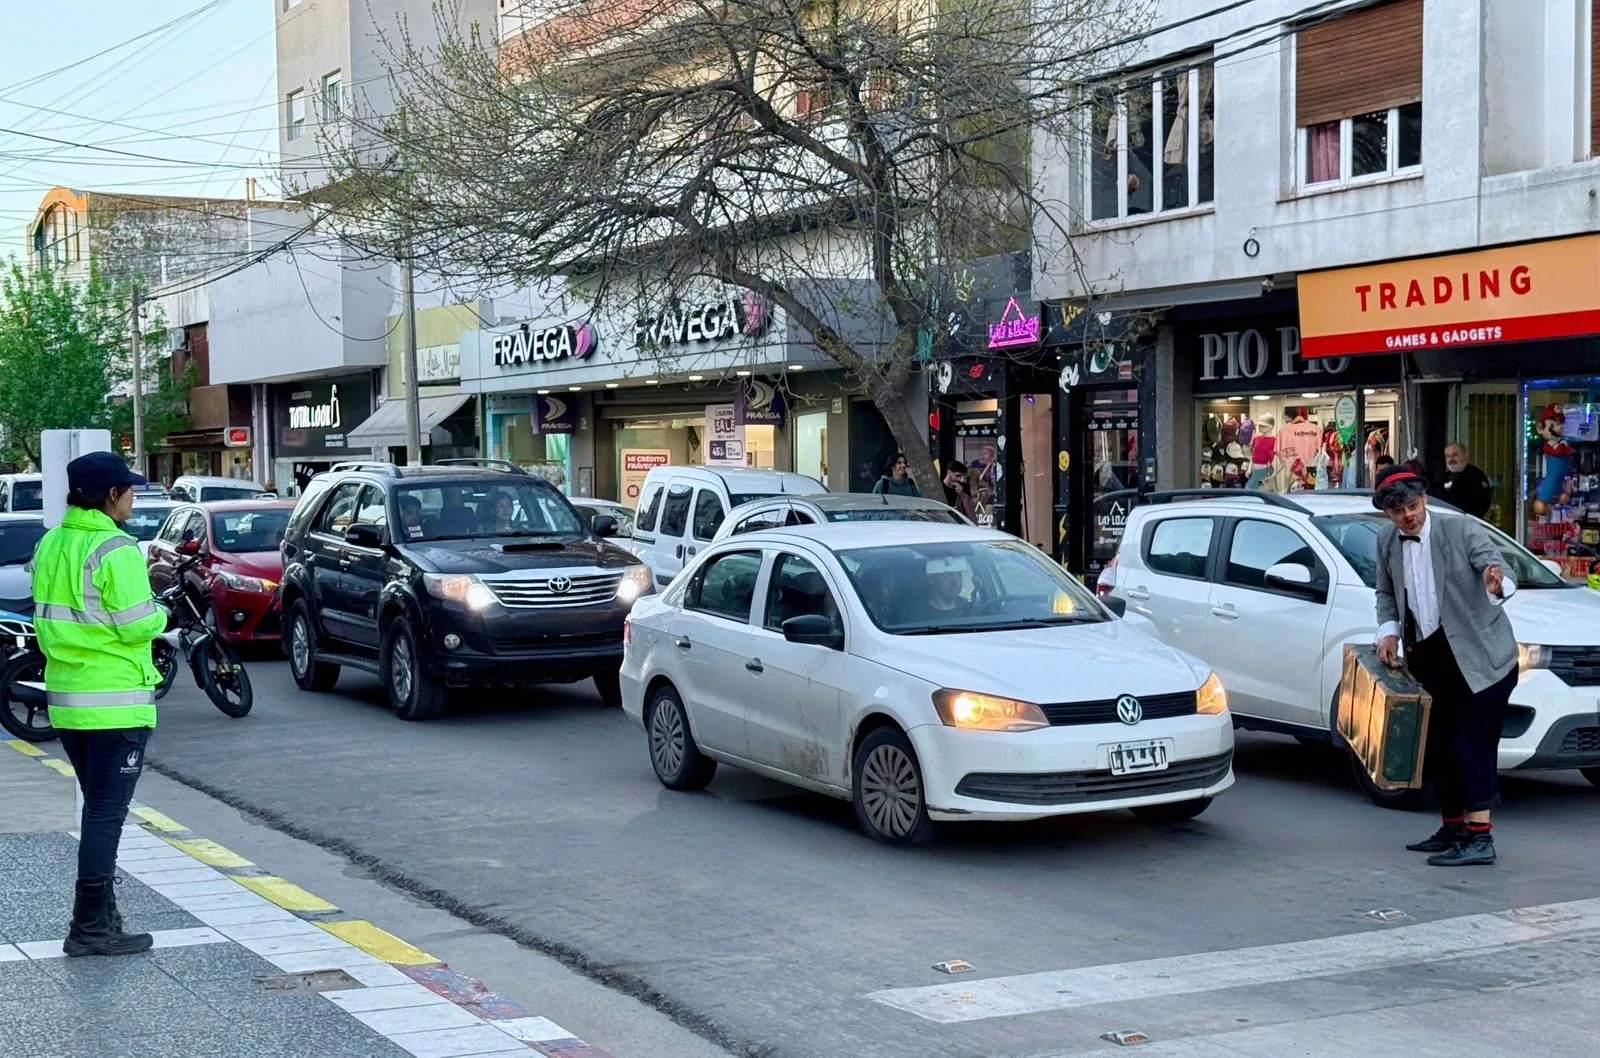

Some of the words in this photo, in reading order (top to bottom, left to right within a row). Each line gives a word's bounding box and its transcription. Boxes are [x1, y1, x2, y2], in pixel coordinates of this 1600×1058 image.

[1355, 265, 1532, 312] TRADING
[1386, 333, 1426, 348] GAMES
[1430, 331, 1438, 344] &
[1442, 326, 1502, 344] GADGETS
[1198, 328, 1269, 381] PIO
[289, 405, 311, 429] TOTAL
[715, 419, 735, 433] SALE
[976, 514, 993, 524] OCAS
